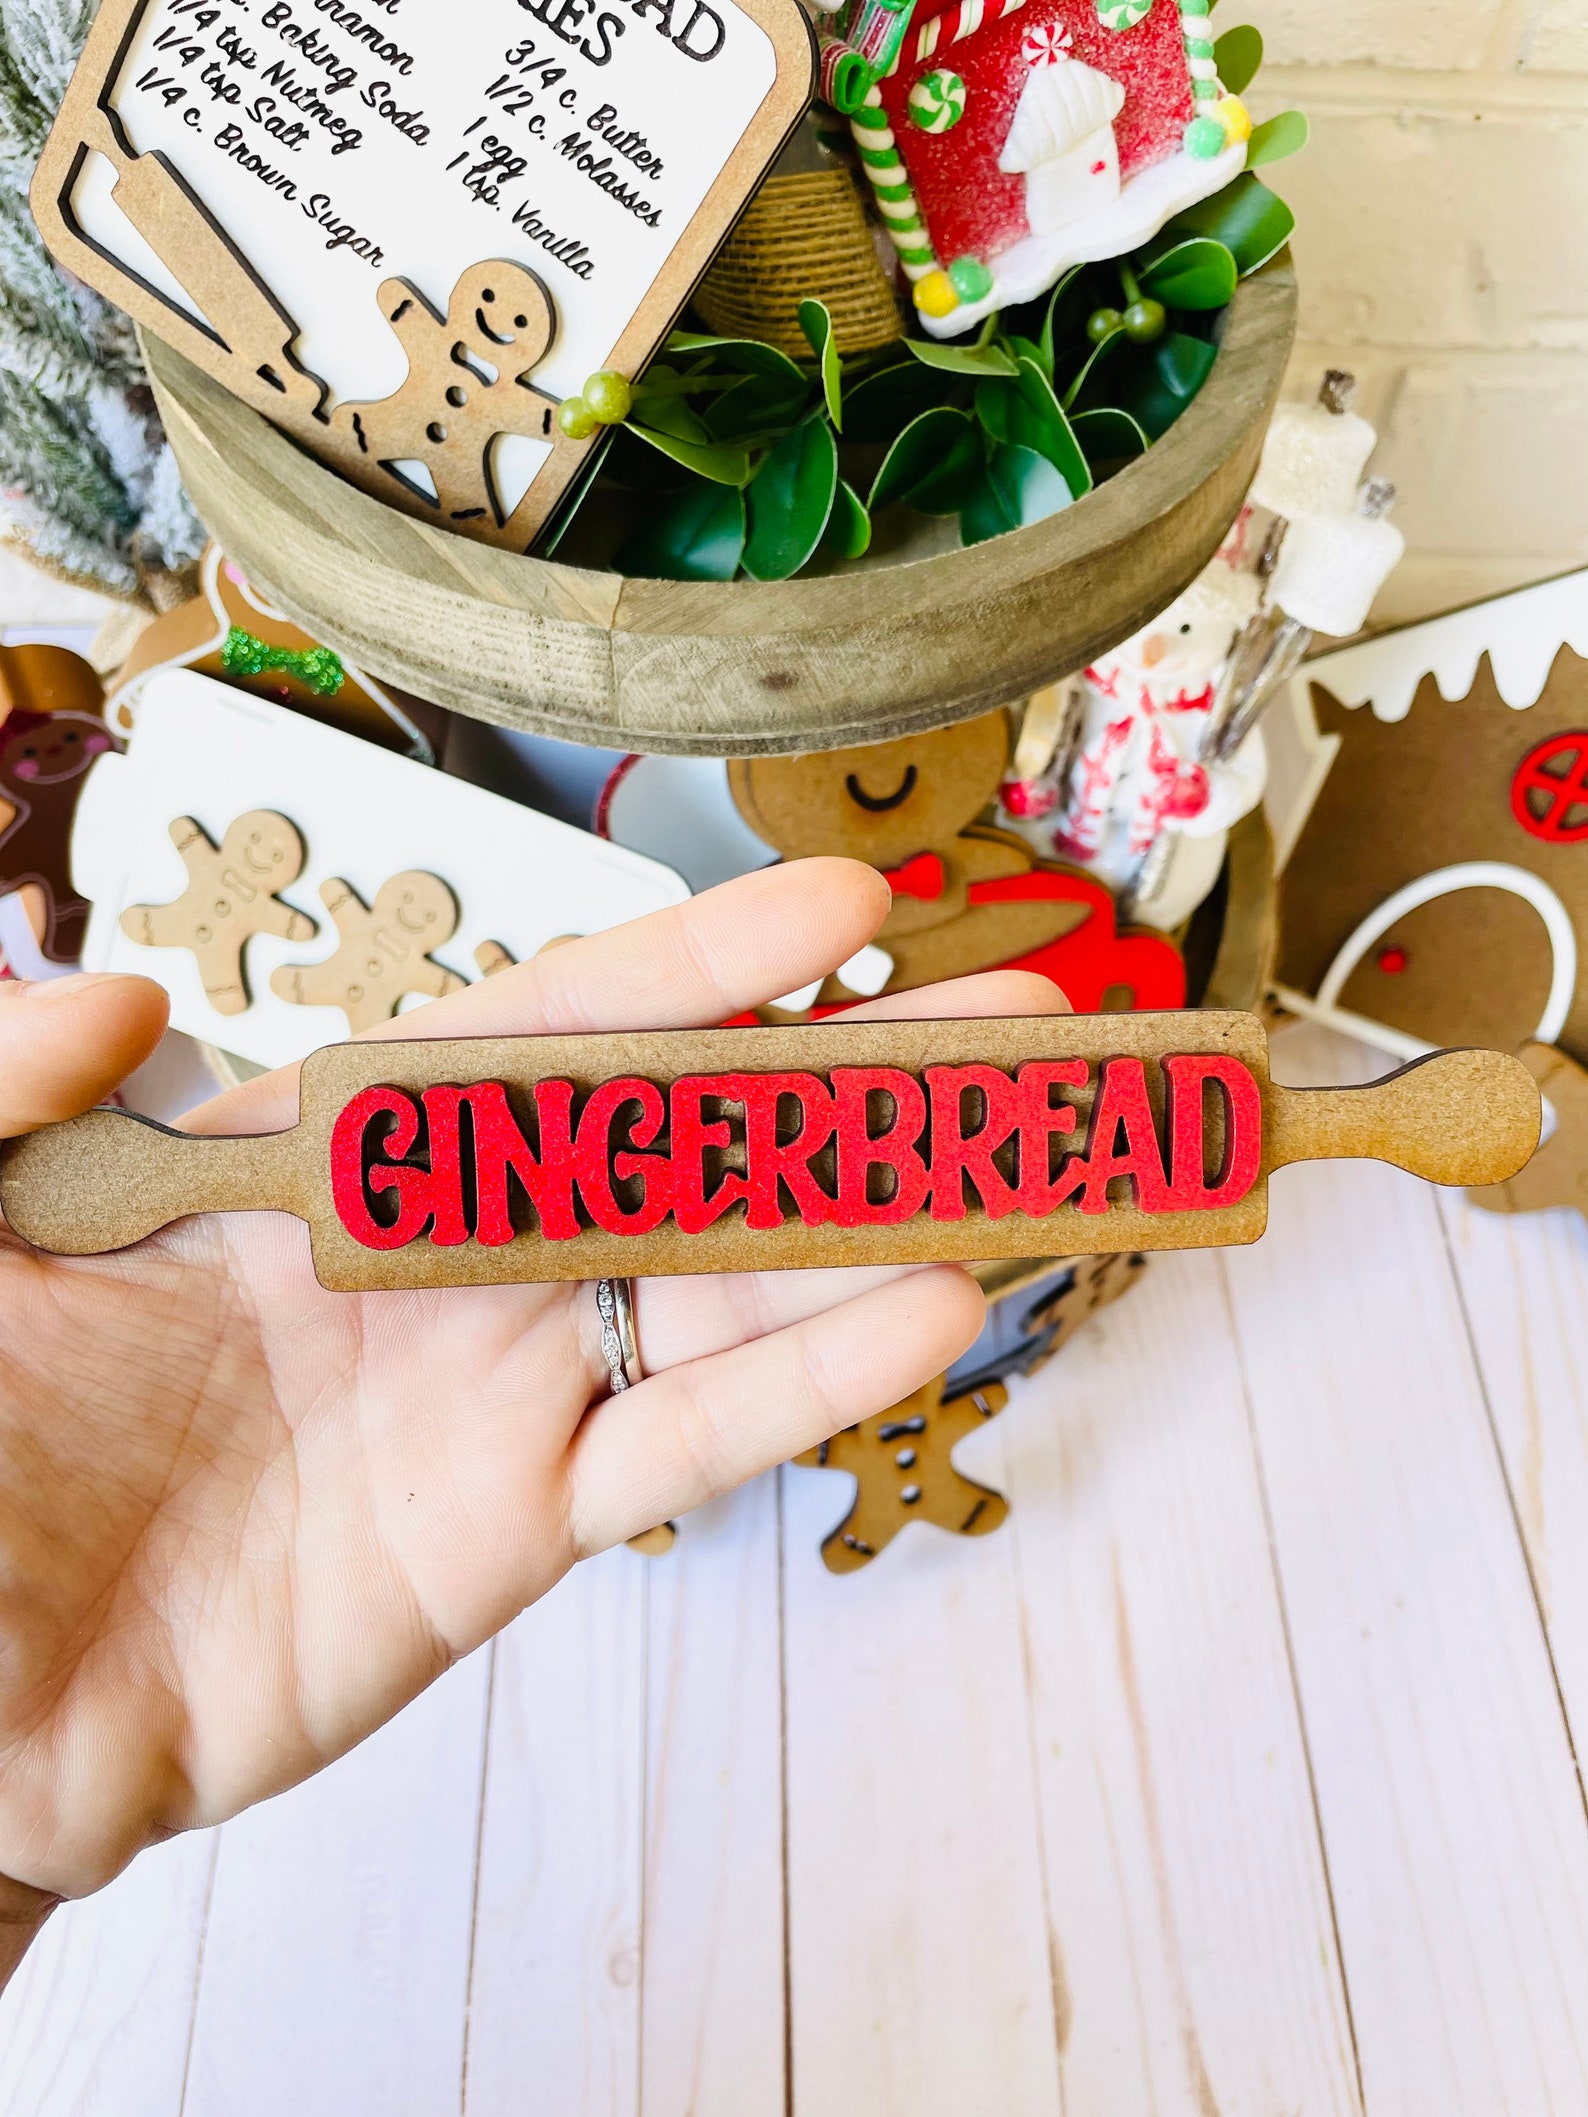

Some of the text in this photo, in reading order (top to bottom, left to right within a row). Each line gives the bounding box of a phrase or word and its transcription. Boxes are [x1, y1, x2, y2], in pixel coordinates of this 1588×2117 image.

[153, 26, 206, 68] 1/4
[244, 96, 310, 152] Salt
[260, 60, 363, 156] Nutmeg
[261, 1, 431, 147] Baking Soda
[506, 39, 664, 180] 3/4 c. Butter
[136, 67, 385, 268] 1/4 c. Brown Sugar
[445, 151, 470, 171] 1
[511, 199, 595, 280] Vanilla
[462, 116, 528, 184] 1 egg
[484, 74, 664, 228] 1/2 c. Molasses
[331, 1053, 1263, 1251] GINGERBREAD
